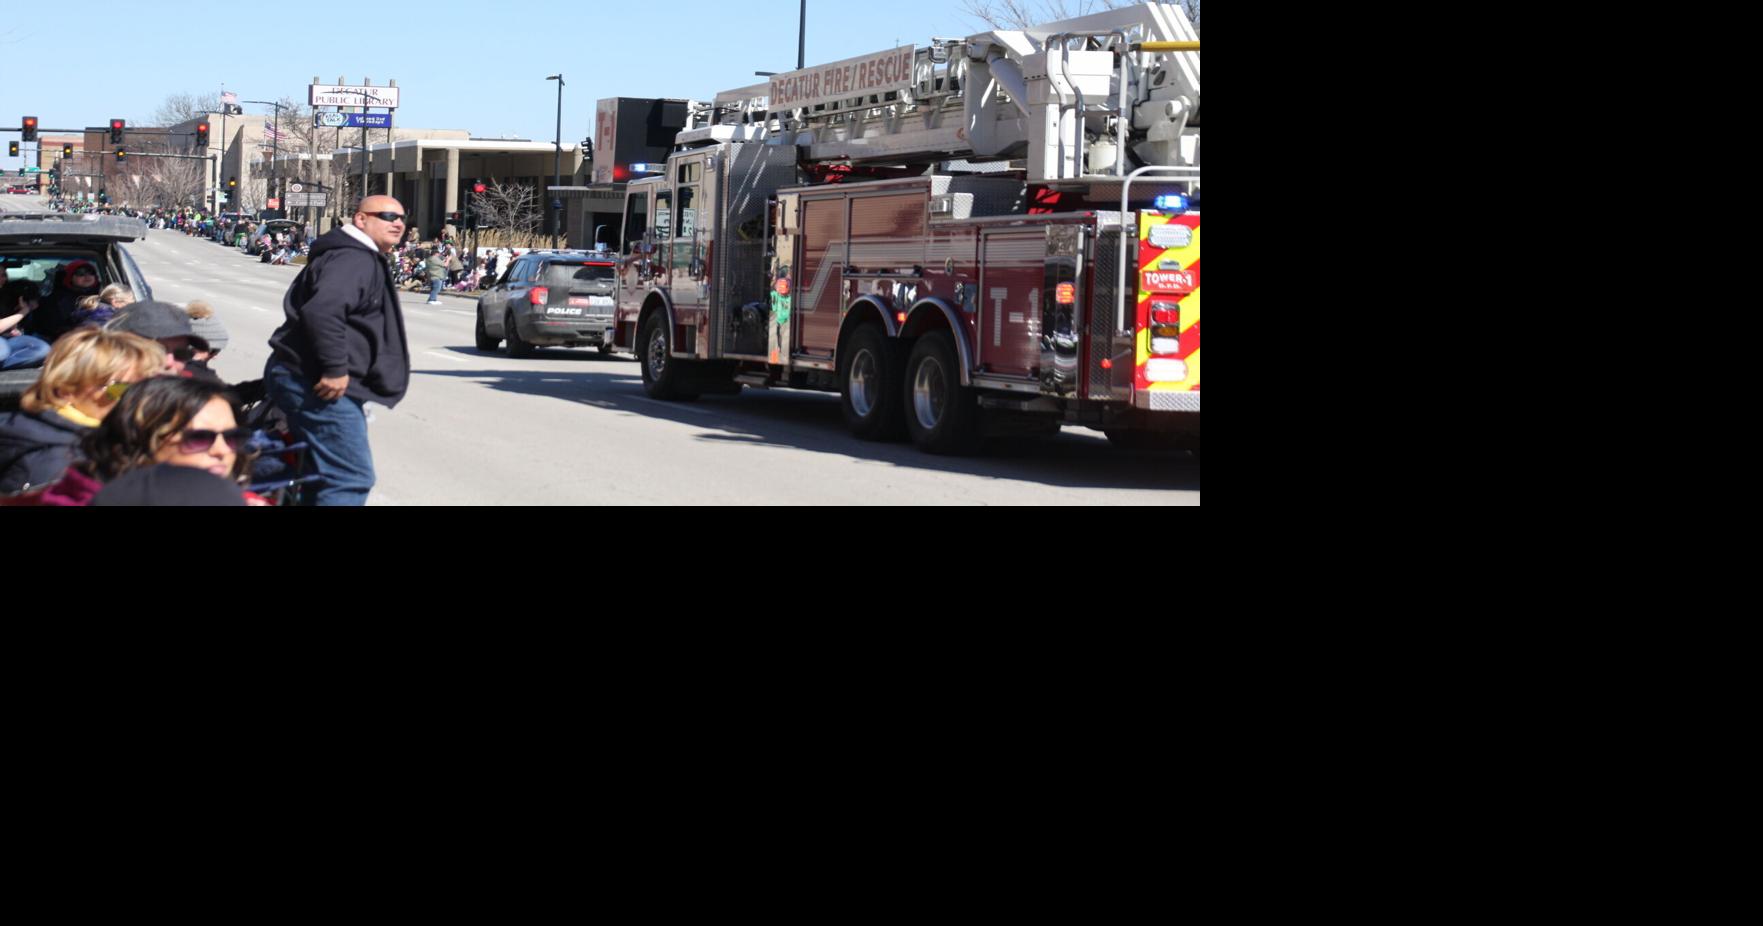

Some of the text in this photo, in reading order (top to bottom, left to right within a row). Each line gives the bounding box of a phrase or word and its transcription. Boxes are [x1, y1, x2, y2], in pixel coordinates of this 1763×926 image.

[770, 72, 820, 106] DECATUR
[315, 95, 394, 106] PUBLIC LIBRARY
[1145, 272, 1193, 287] TOWER-1
[546, 307, 582, 315] POLICE
[990, 287, 1039, 348] T-1
